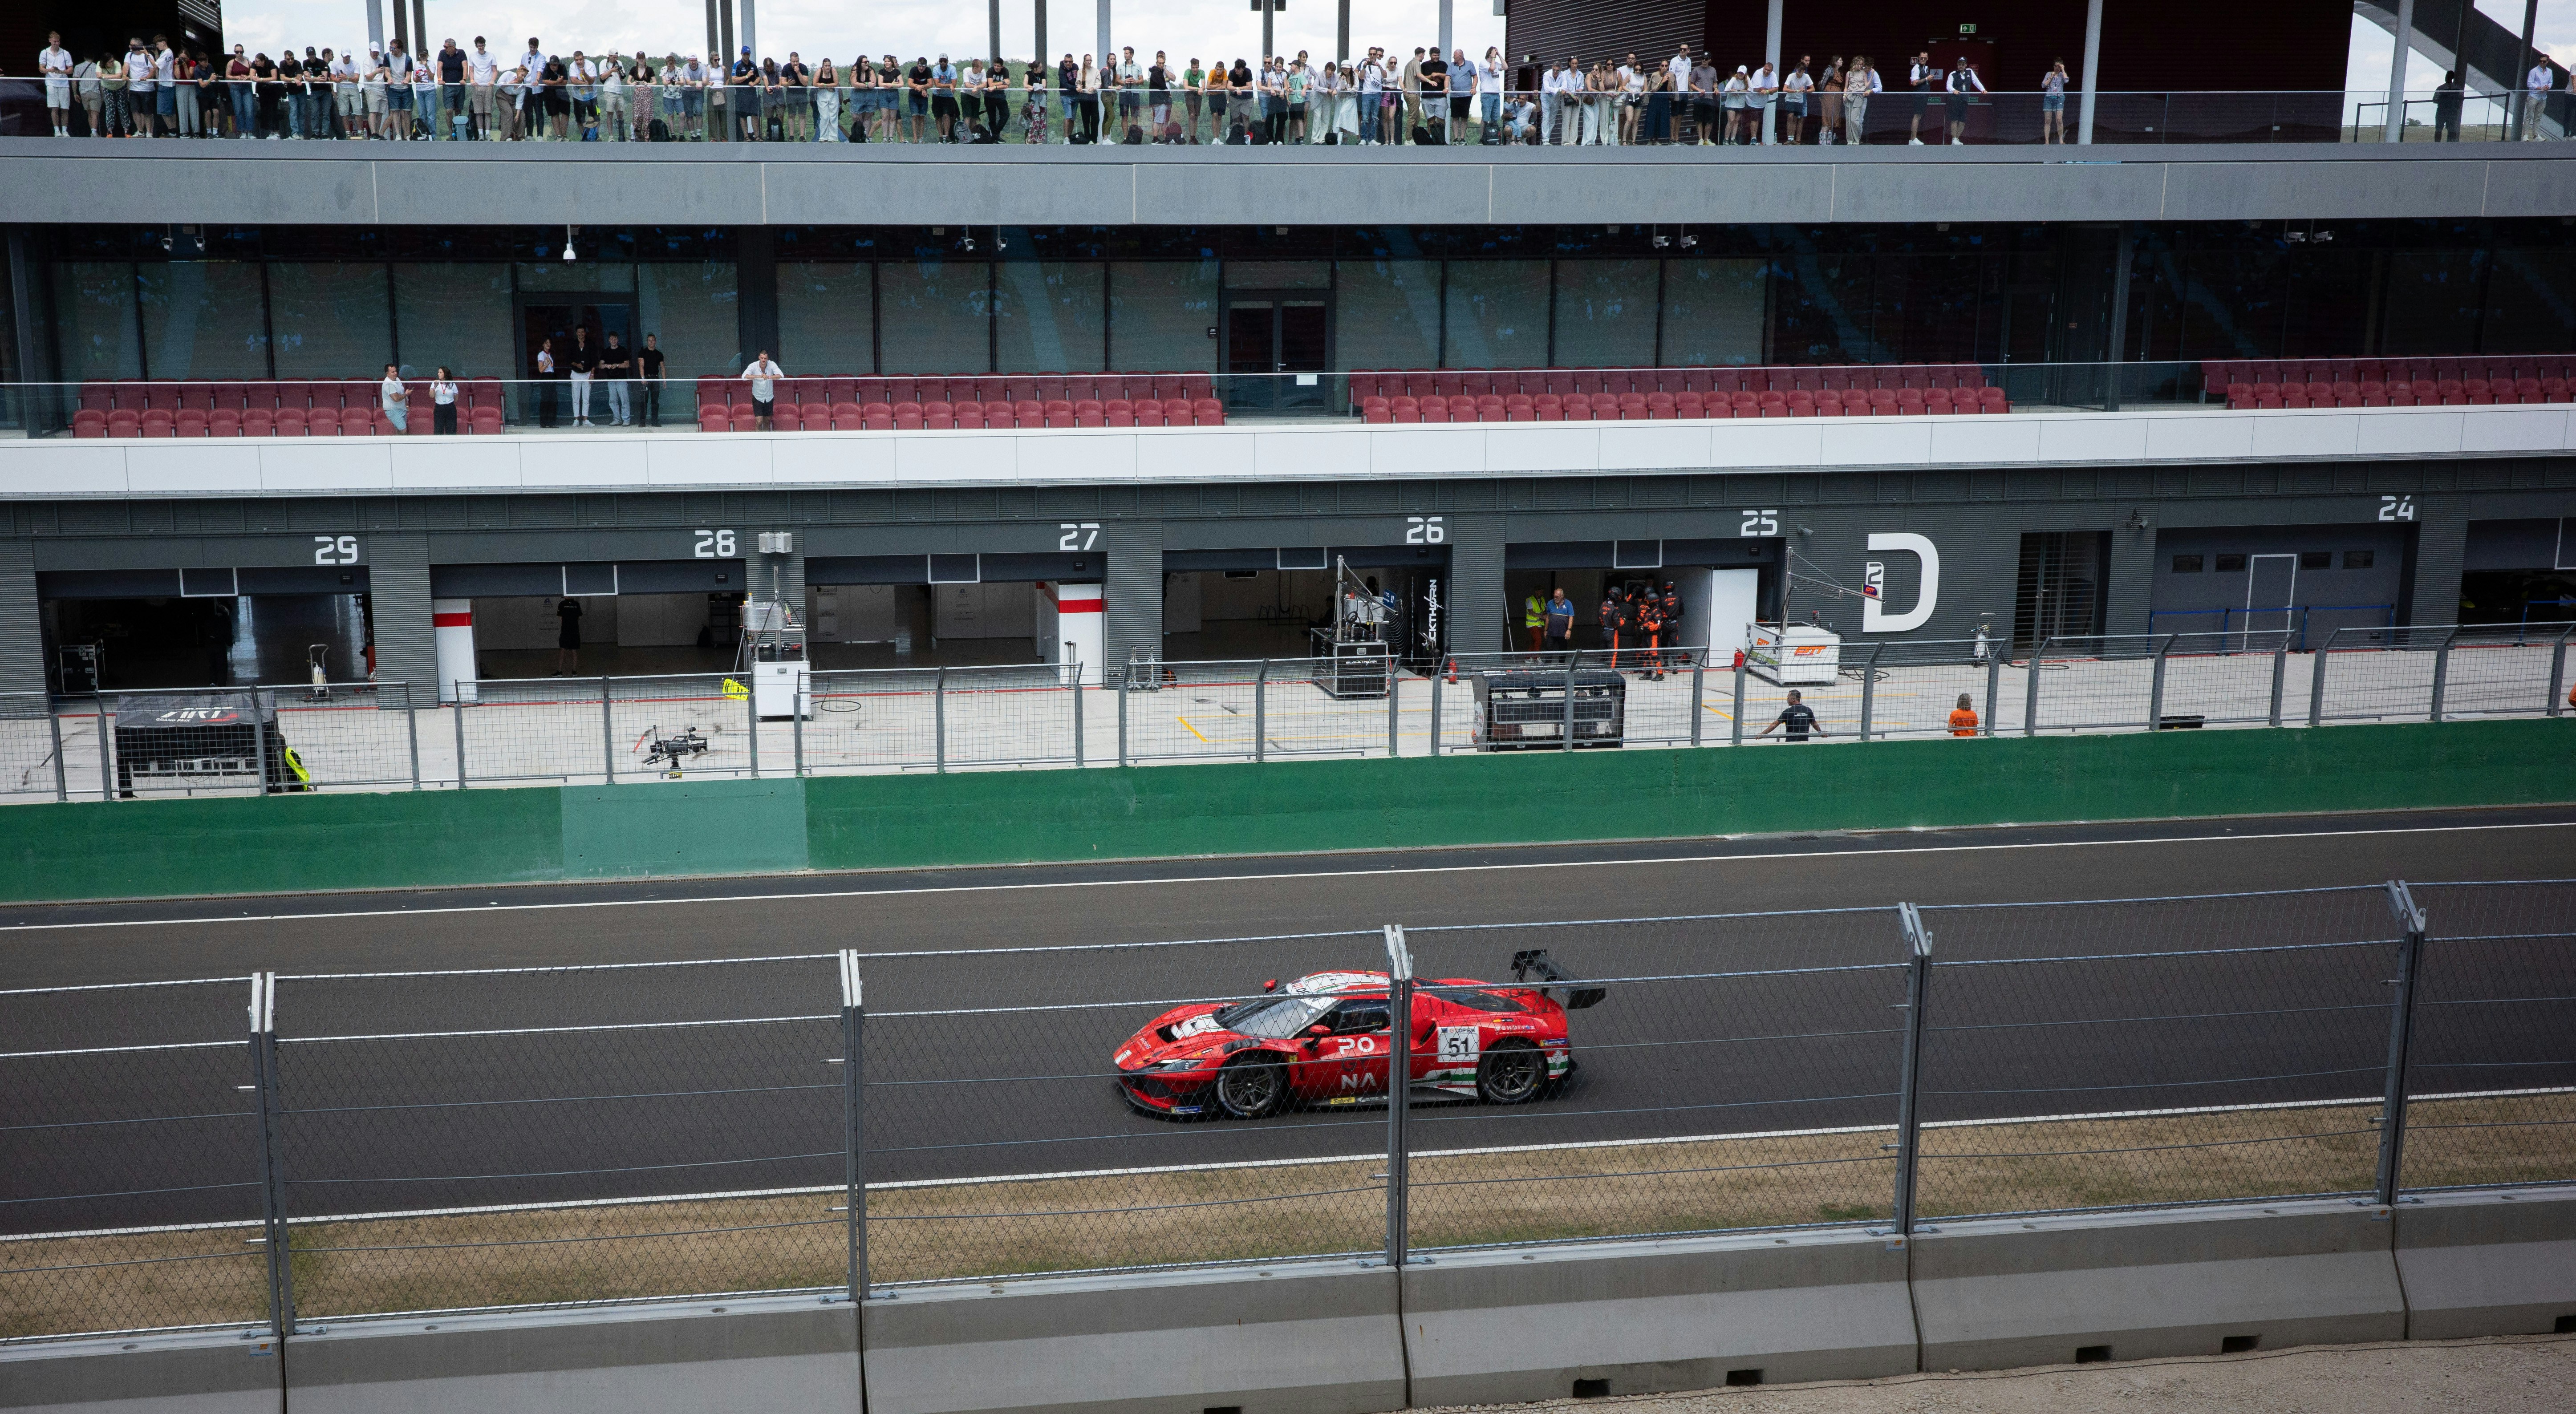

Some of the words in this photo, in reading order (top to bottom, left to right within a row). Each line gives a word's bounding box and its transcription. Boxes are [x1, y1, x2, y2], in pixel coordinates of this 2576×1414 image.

[2379, 496, 2414, 521] 24
[1406, 517, 1444, 543] 26
[1741, 510, 1777, 536] 25
[315, 536, 358, 564] 29
[695, 530, 735, 558] 28
[1060, 523, 1100, 551] 27
[1863, 533, 1939, 632] D
[1867, 563, 1882, 585] 2
[1337, 1037, 1375, 1054] PO
[1448, 1037, 1469, 1057] 51
[1341, 1072, 1377, 1090] NA
